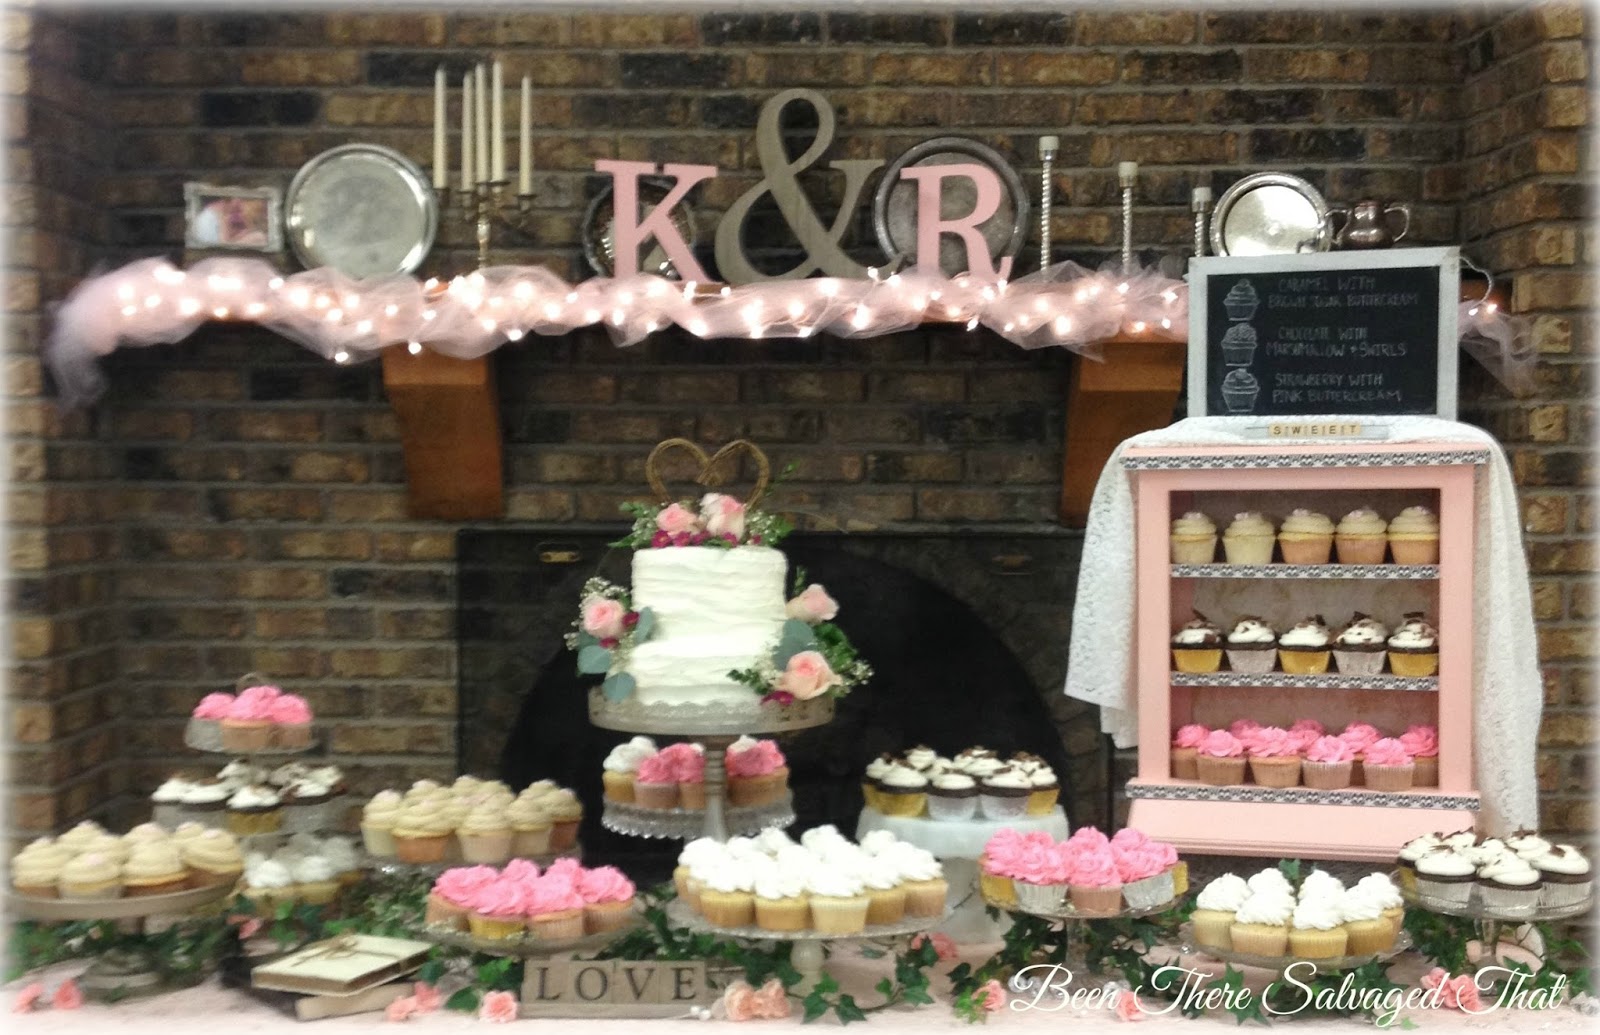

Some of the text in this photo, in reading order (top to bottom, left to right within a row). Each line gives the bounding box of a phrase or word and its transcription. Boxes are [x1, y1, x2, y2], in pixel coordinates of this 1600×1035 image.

[595, 89, 1013, 283] K & R
[1337, 274, 1375, 290] WITH
[1337, 326, 1369, 340] WITH
[1274, 372, 1384, 386] STRAWBERRY WITH
[1272, 388, 1402, 403] PINK BUTTERCREAM
[1273, 424, 1357, 436] SWEET
[534, 966, 698, 1001] LOVE
